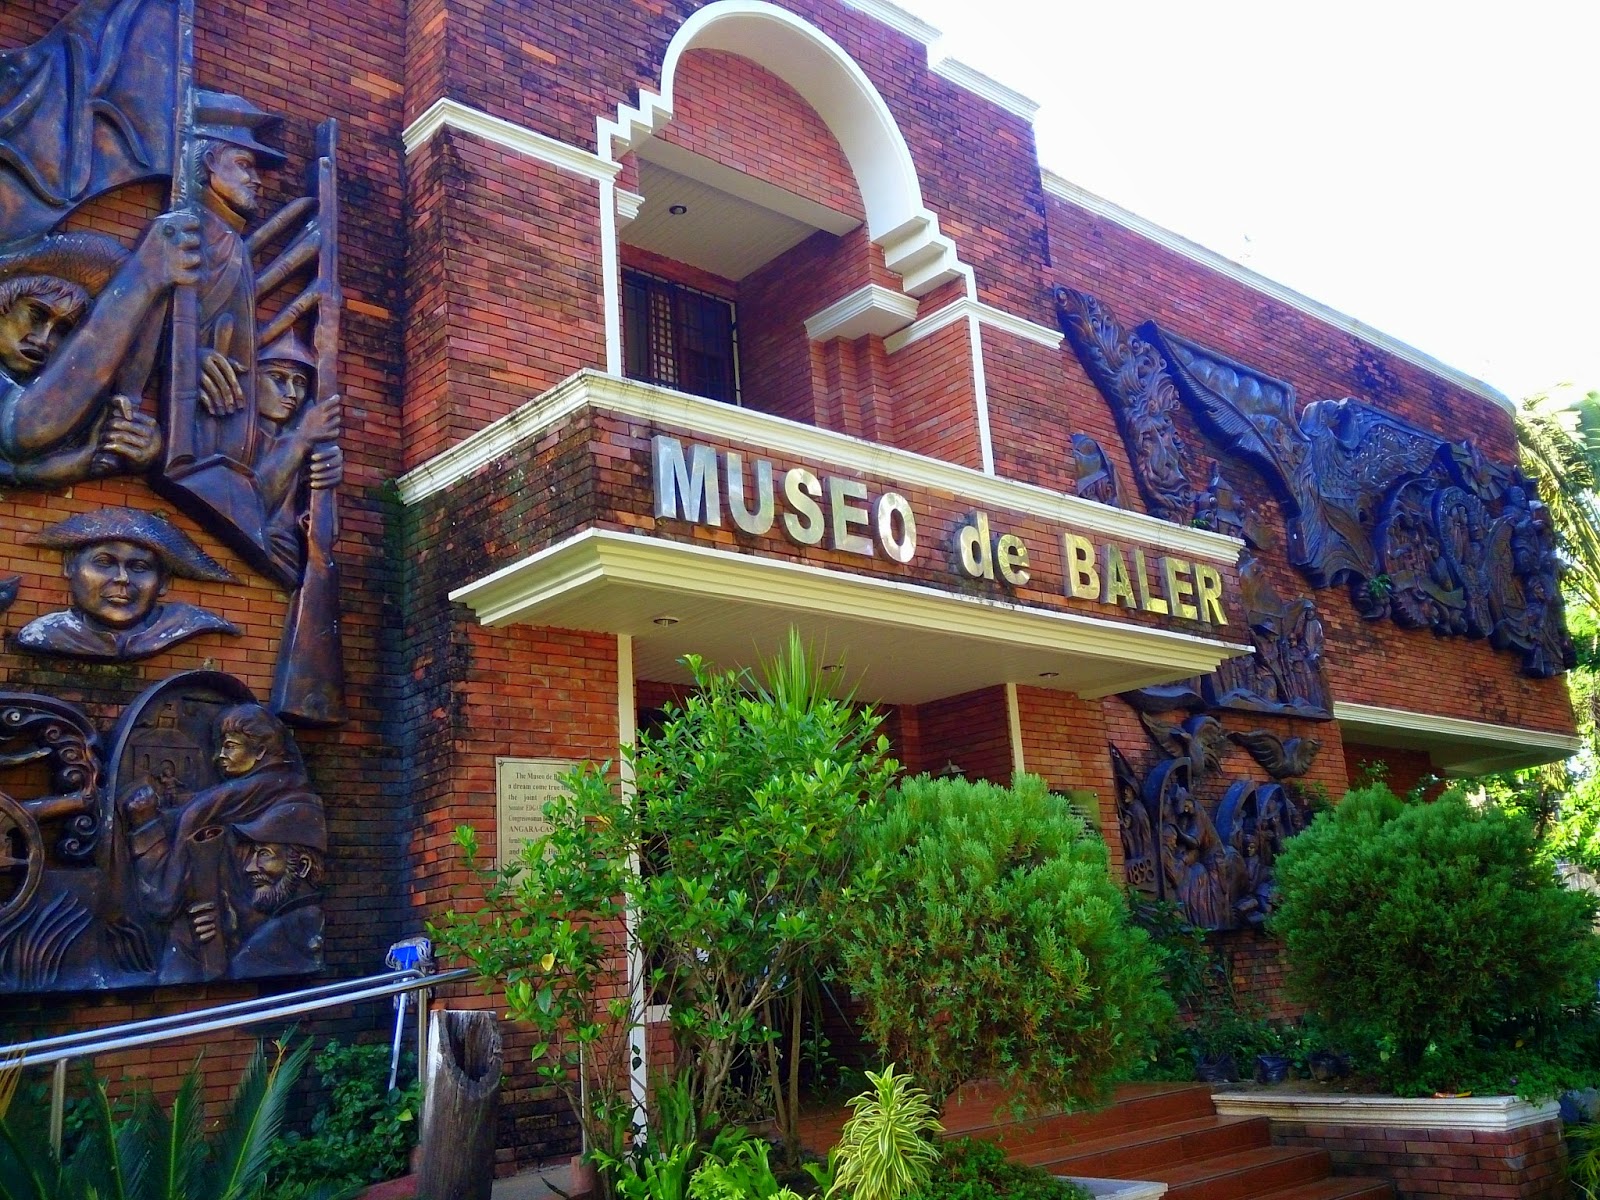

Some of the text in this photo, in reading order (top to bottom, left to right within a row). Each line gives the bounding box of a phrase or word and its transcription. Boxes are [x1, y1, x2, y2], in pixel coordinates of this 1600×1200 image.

[651, 435, 1230, 626] MUSEO de BALER
[516, 772, 526, 780] The
[1128, 859, 1155, 885] 1898
